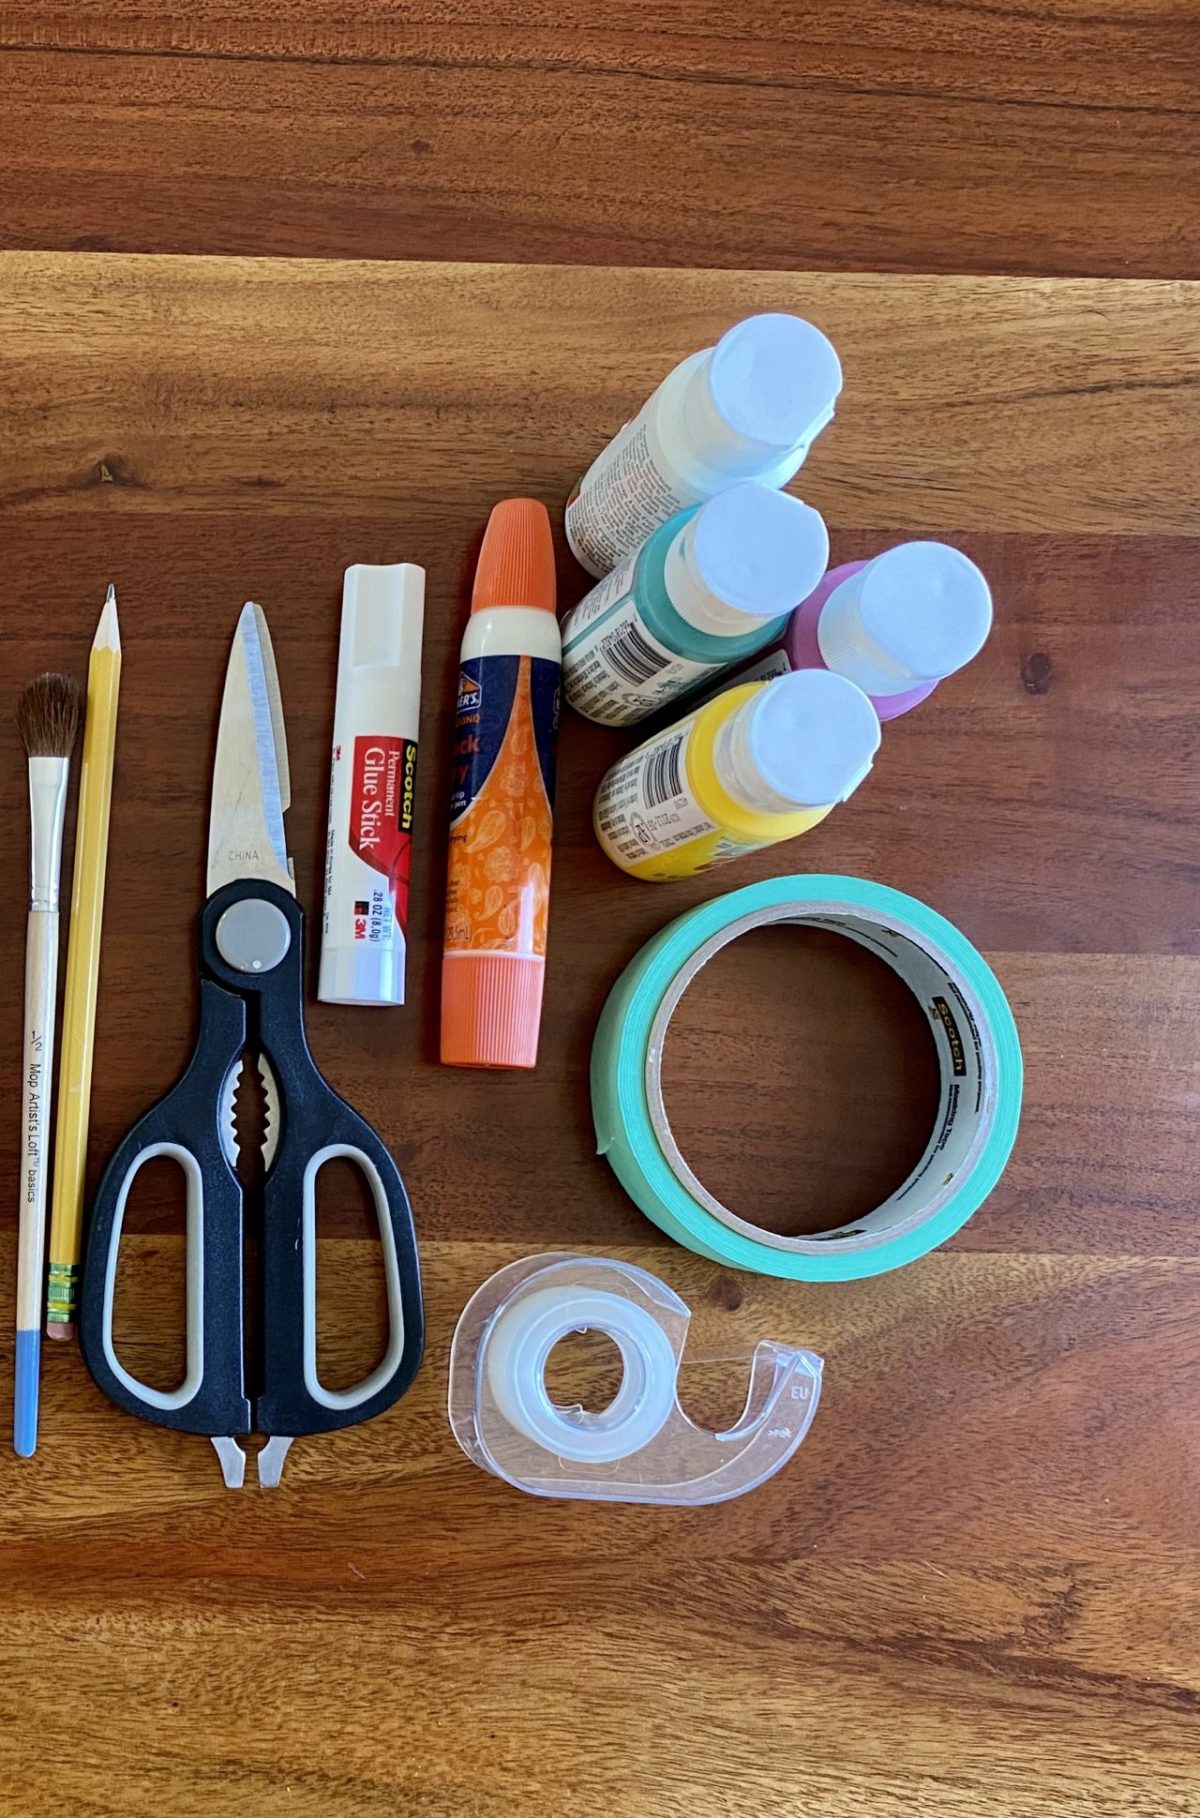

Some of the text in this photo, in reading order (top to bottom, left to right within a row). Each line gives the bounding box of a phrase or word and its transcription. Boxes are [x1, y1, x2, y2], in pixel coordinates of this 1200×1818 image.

[384, 750, 400, 817] Permanent
[402, 744, 416, 829] Scotch
[359, 746, 386, 851] Glue Stick
[228, 849, 260, 862] CHINA
[372, 903, 383, 916] OZ
[382, 906, 392, 922] NET
[354, 918, 367, 940] 3M
[369, 917, 382, 943] (8.0g)
[937, 1002, 963, 1071] Scotch
[27, 1063, 42, 1088] Mop
[28, 1092, 41, 1132] Artist's
[27, 1169, 38, 1204] basics
[790, 1385, 809, 1400] EU
